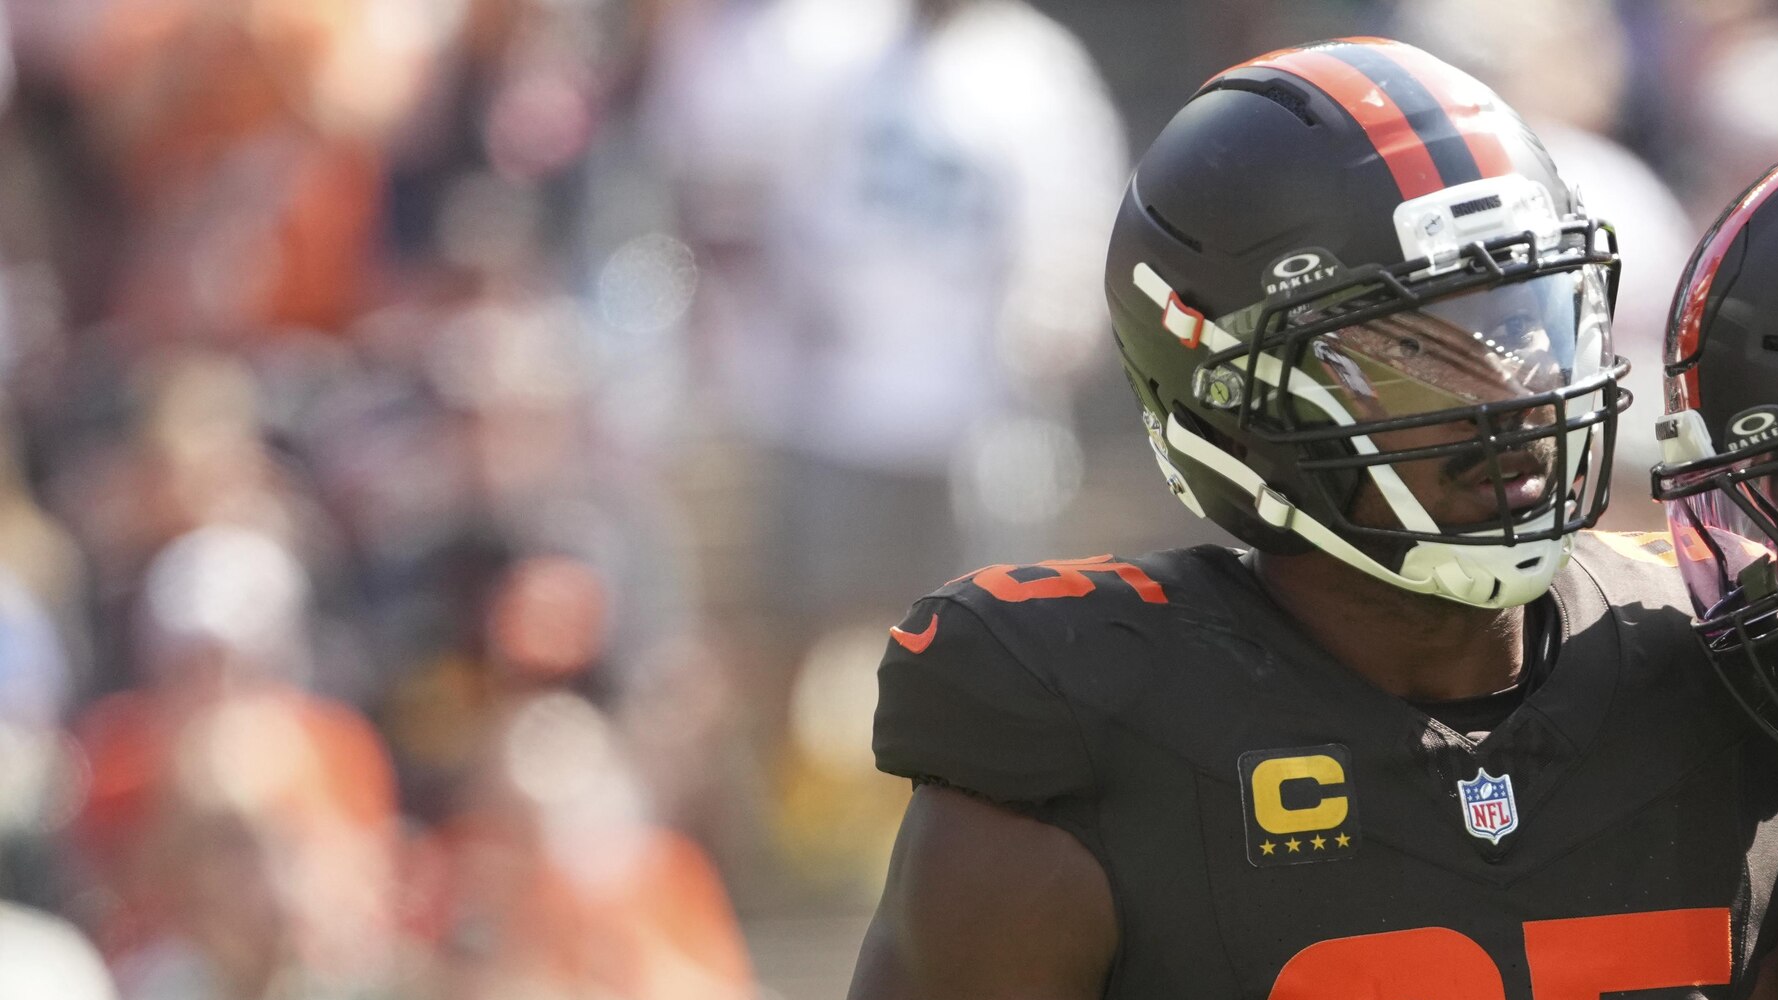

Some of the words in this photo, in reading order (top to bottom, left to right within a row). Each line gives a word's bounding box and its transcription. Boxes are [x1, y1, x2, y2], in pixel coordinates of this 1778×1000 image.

[1267, 265, 1336, 295] OAKLEY
[1252, 755, 1348, 834] C
[1472, 801, 1510, 830] NFL
